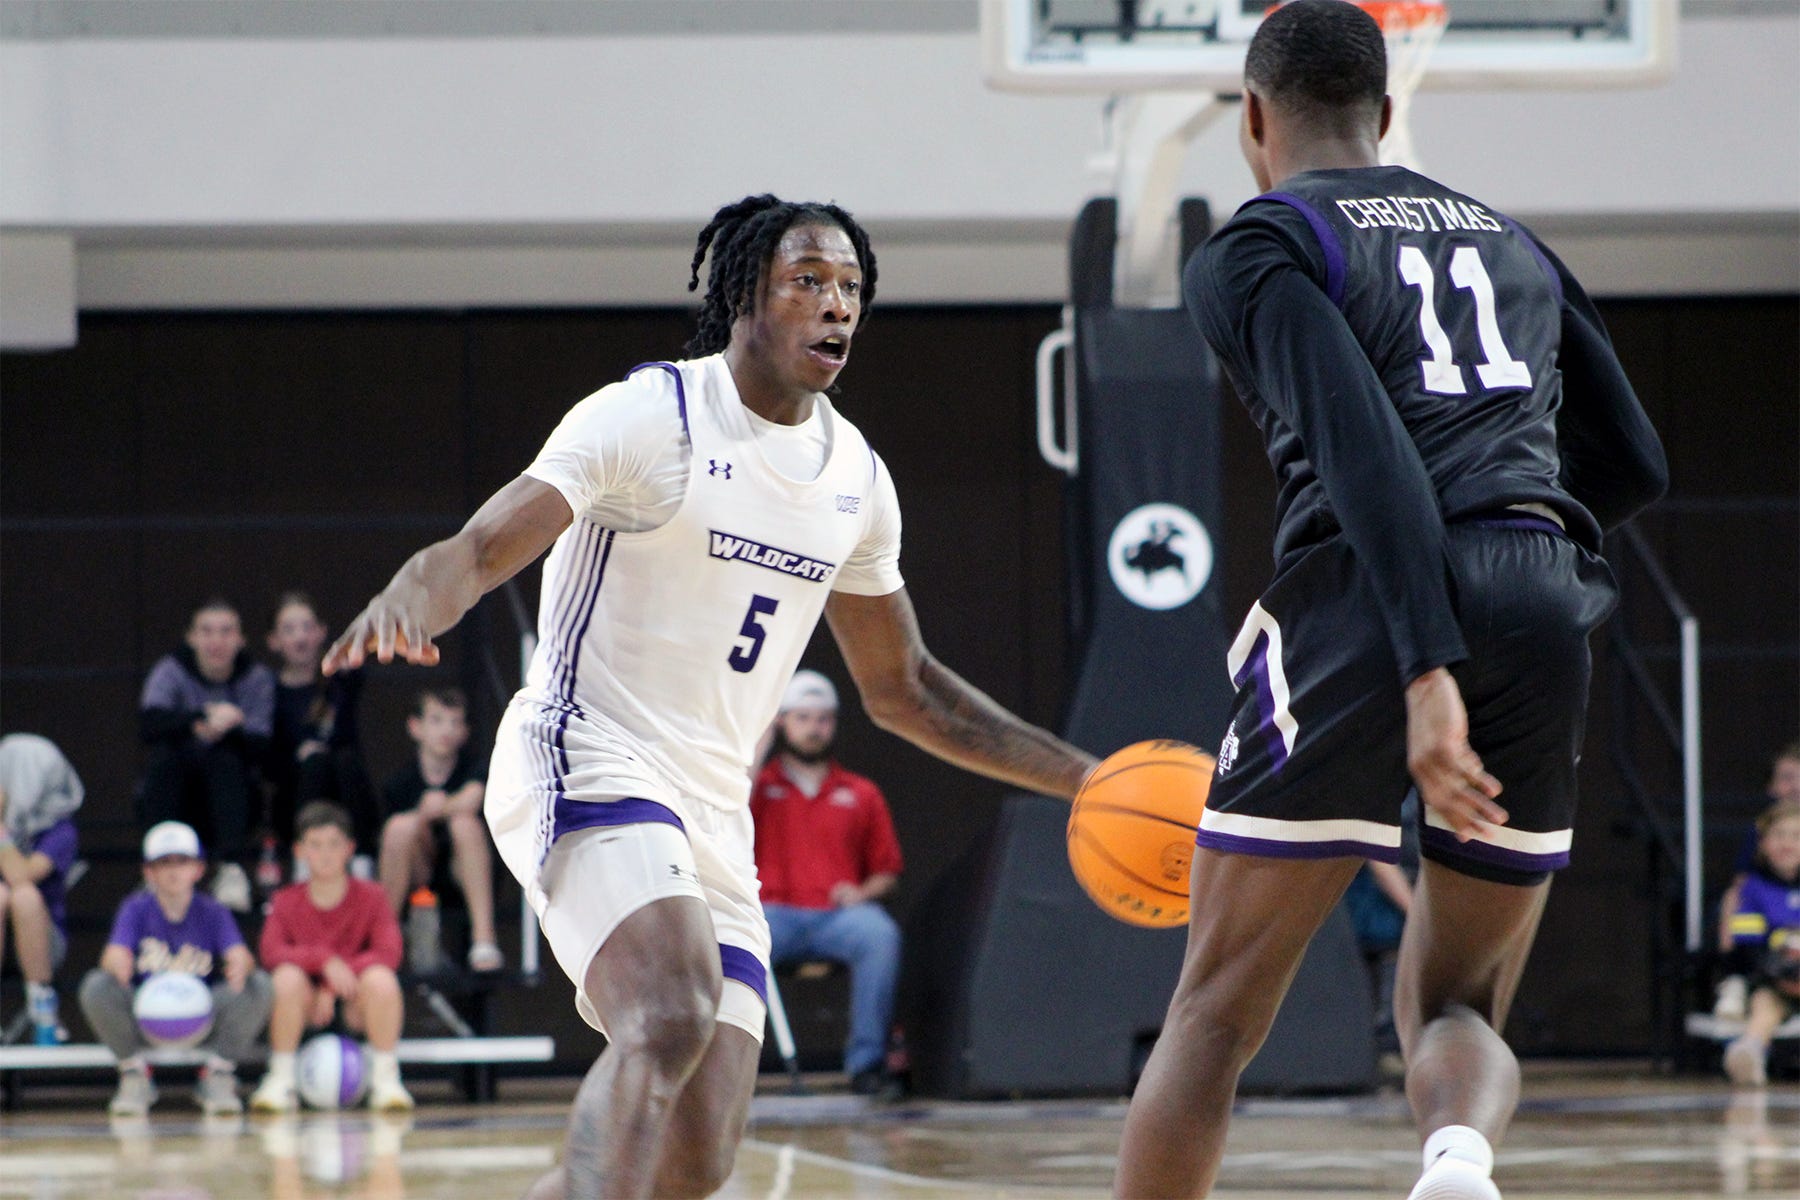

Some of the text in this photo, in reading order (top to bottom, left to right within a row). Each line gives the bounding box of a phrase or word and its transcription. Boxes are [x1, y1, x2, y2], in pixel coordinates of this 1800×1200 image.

[1336, 196, 1502, 232] CHRISTMAS
[1398, 245, 1533, 394] 11
[709, 529, 835, 582] WILDCATS
[727, 594, 779, 673] 5
